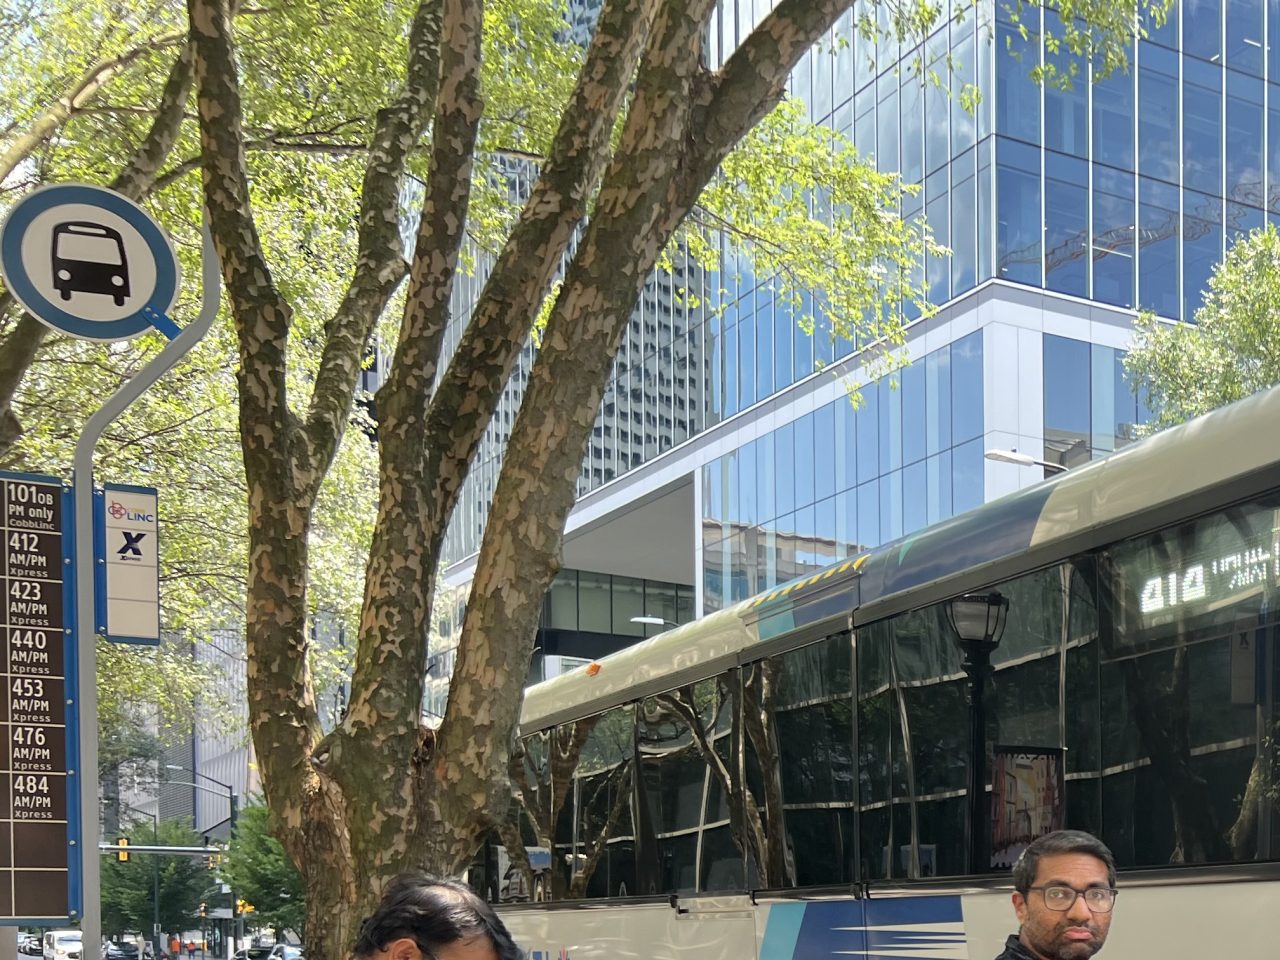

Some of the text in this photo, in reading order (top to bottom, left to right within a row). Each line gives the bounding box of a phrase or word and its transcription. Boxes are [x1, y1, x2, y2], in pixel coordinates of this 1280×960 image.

[8, 504, 54, 522] PM only
[127, 512, 154, 522] LINC
[9, 532, 39, 552] 412
[117, 531, 147, 556] X
[9, 553, 47, 567] AM/PM
[10, 567, 48, 578] Xpress
[10, 581, 41, 601] 423
[10, 601, 48, 615] AM/PM
[11, 615, 49, 626] Xpress
[11, 630, 46, 649] 440
[11, 650, 48, 664] AM/PM
[12, 664, 50, 675] Xpress
[12, 678, 43, 697] 453
[12, 699, 49, 712] AM/PM
[13, 713, 51, 723] Xpress
[13, 727, 46, 746] 476
[13, 747, 50, 760] AM/PM
[14, 761, 52, 771] Xpress
[14, 775, 49, 794] 484
[14, 796, 51, 809] AM/PM
[15, 810, 53, 820] Xpress
